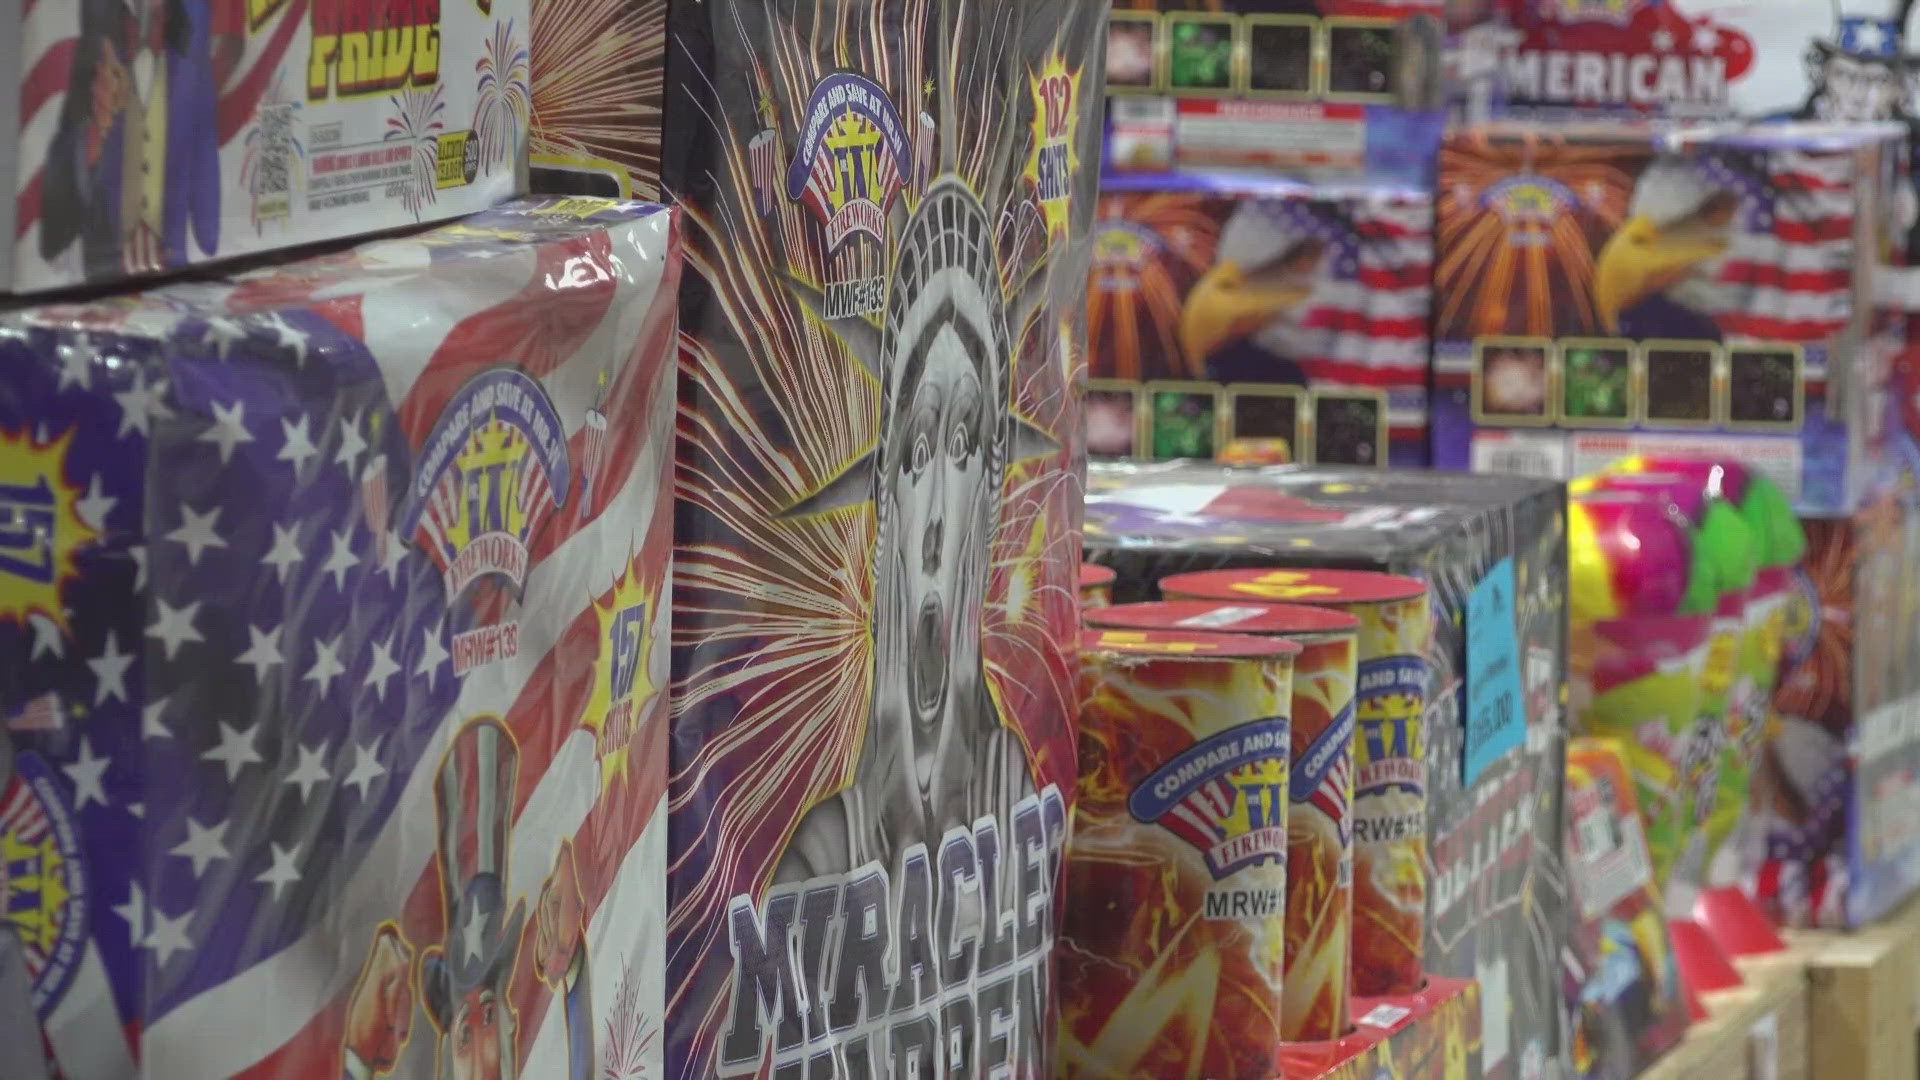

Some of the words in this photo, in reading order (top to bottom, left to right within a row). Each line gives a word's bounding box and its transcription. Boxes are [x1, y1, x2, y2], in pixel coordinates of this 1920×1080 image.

[803, 95, 829, 166] COMPARE
[828, 84, 846, 110] AND
[845, 83, 868, 108] SAVE
[869, 93, 882, 118] AT
[1039, 73, 1071, 139] 162
[830, 201, 884, 245] FIREWORKS
[451, 536, 522, 595] FIREWORKS
[609, 601, 647, 703] 157
[1153, 741, 1240, 800] COMPARE
[1242, 732, 1274, 754] AND
[1206, 888, 1281, 917] MRW#
